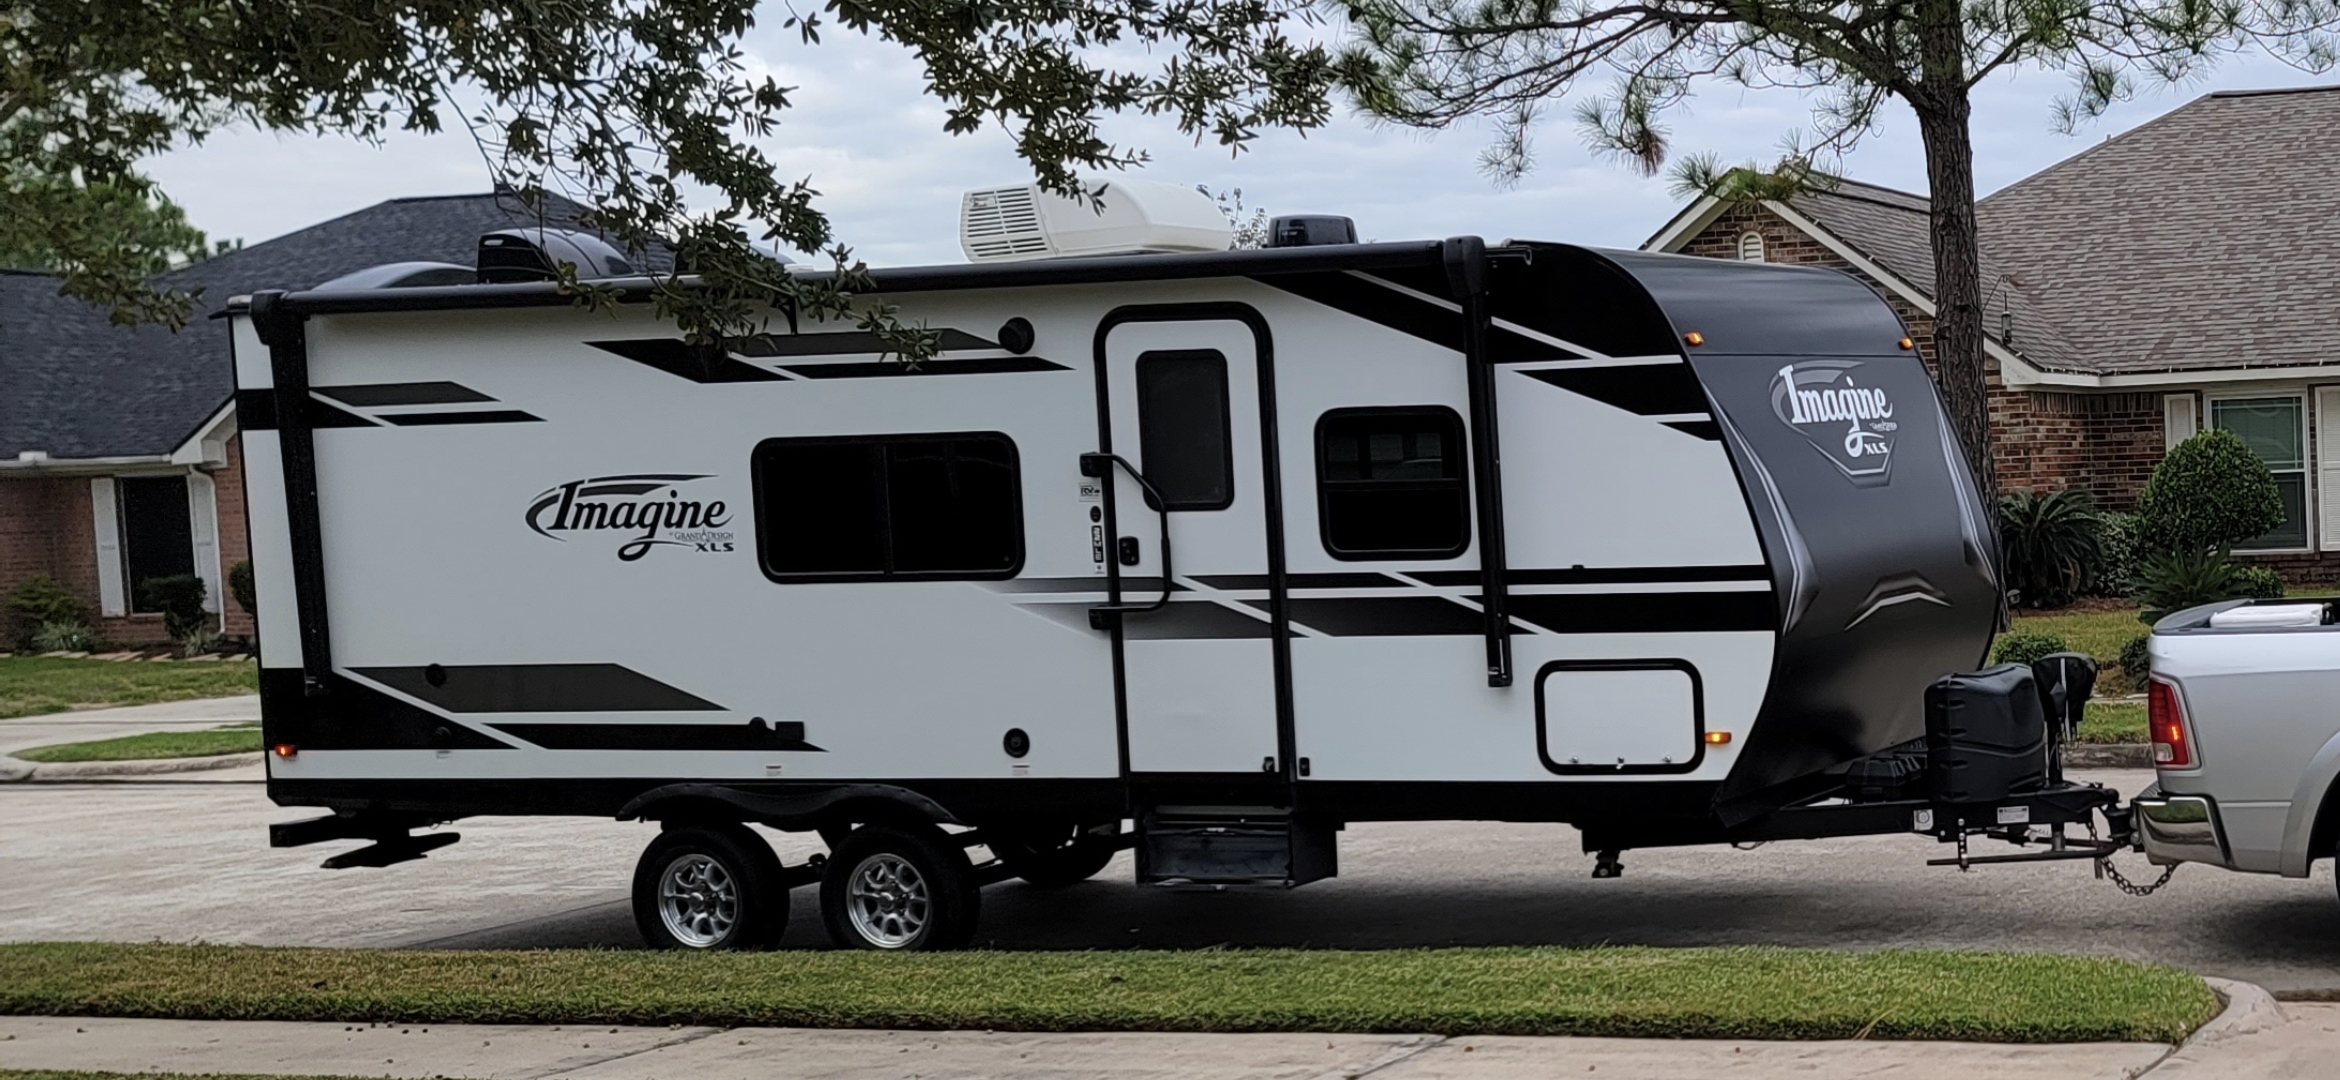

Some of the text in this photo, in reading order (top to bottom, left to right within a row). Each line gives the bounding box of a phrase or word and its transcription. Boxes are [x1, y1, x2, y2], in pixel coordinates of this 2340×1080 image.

[1779, 365, 1893, 457] Imagine
[1864, 442, 1888, 455] XLS
[547, 479, 734, 561] Imagine
[695, 542, 734, 552] XLS
